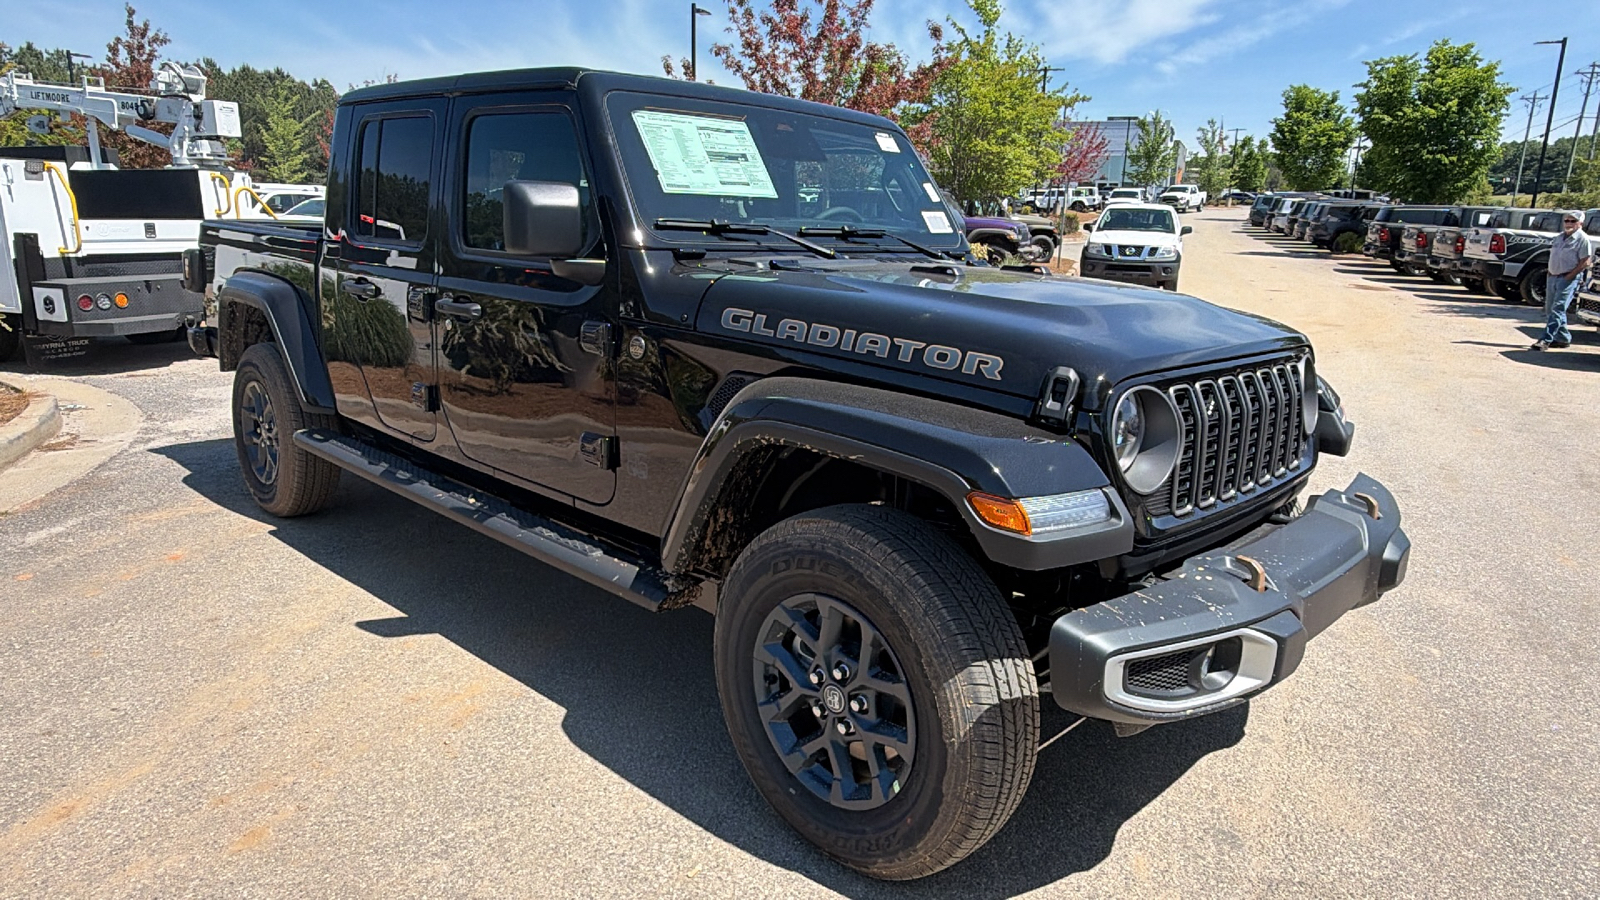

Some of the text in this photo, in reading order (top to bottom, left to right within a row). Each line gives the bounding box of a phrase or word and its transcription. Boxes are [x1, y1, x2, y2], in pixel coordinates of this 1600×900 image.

[30, 91, 71, 103] LIFTMOORE
[67, 339, 89, 347] TRUCK
[720, 307, 1004, 381] GLADIATOR
